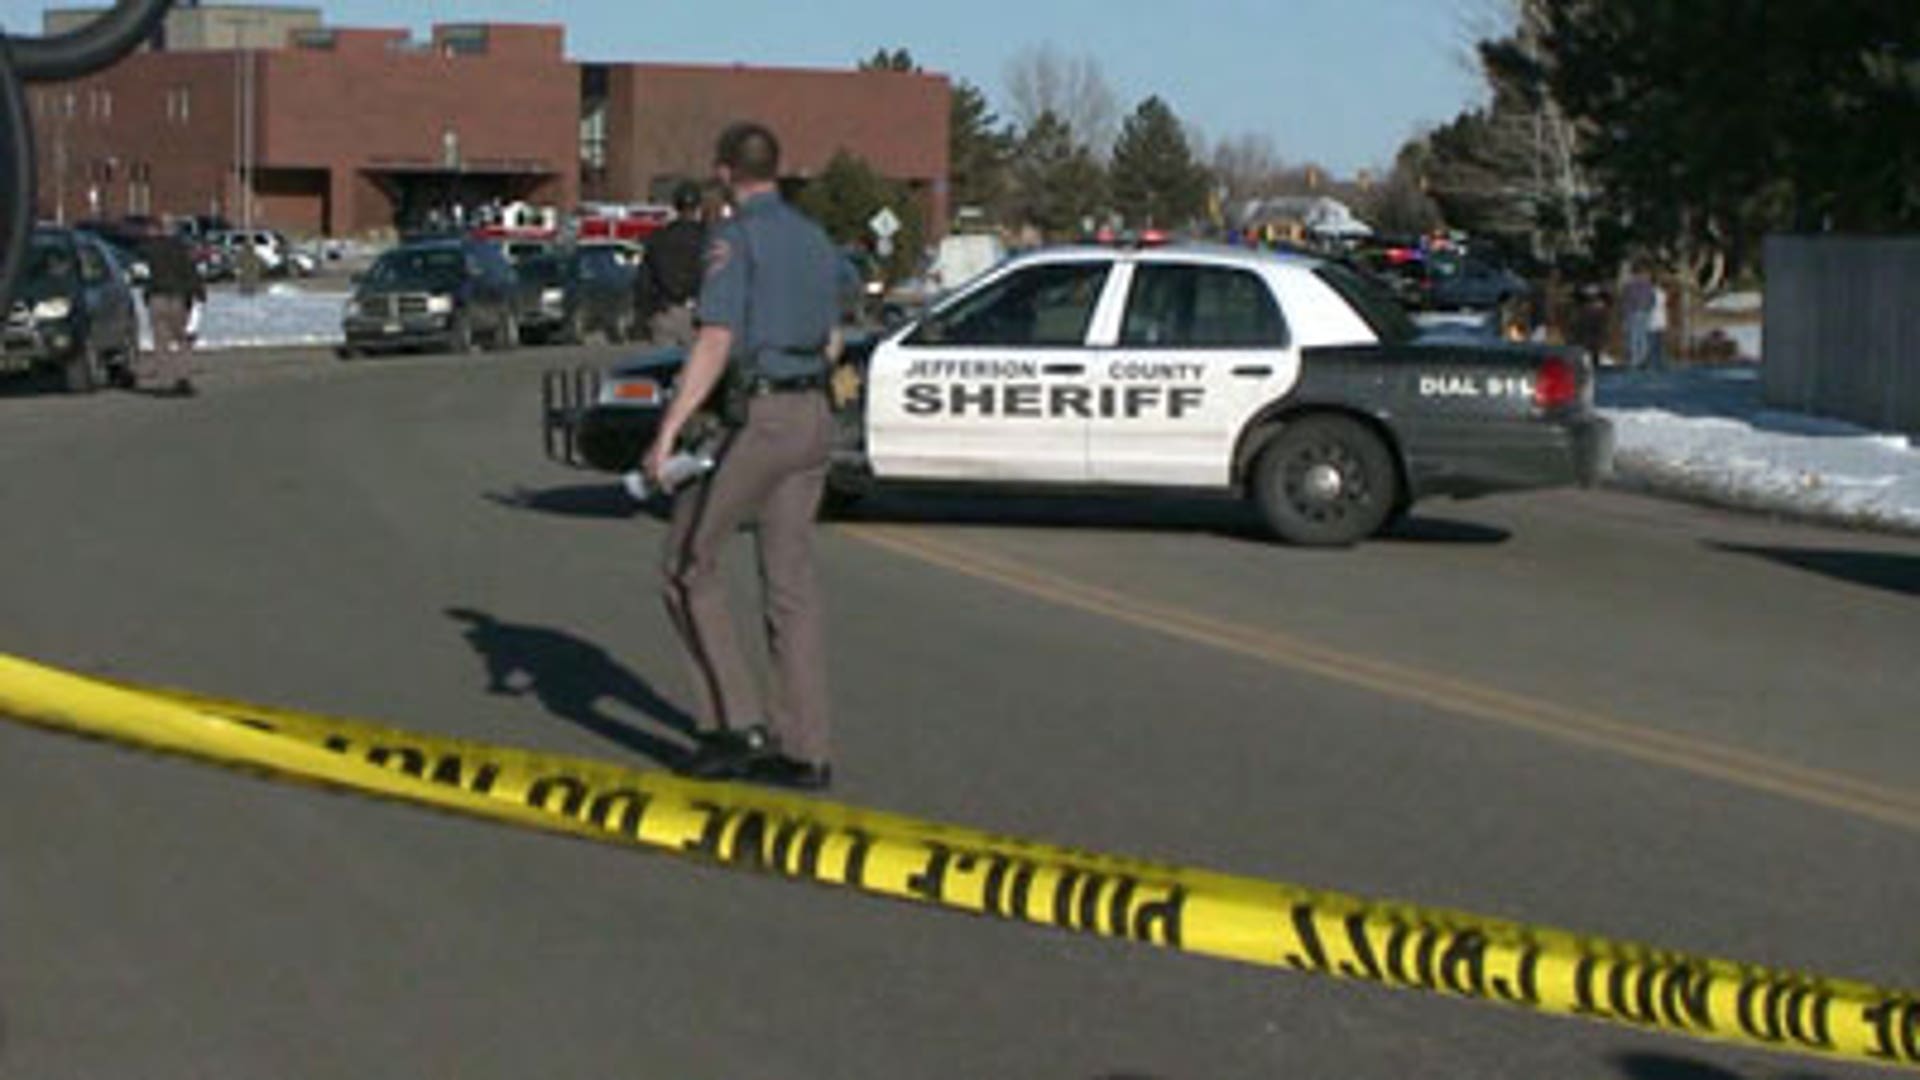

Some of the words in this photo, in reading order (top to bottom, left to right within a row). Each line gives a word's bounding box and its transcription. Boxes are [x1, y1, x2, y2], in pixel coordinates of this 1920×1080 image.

[905, 359, 1037, 379] JEFFERSON
[1108, 361, 1205, 380] COUNTY
[1419, 375, 1481, 396] DIAL
[902, 383, 1206, 418] SHERIFF
